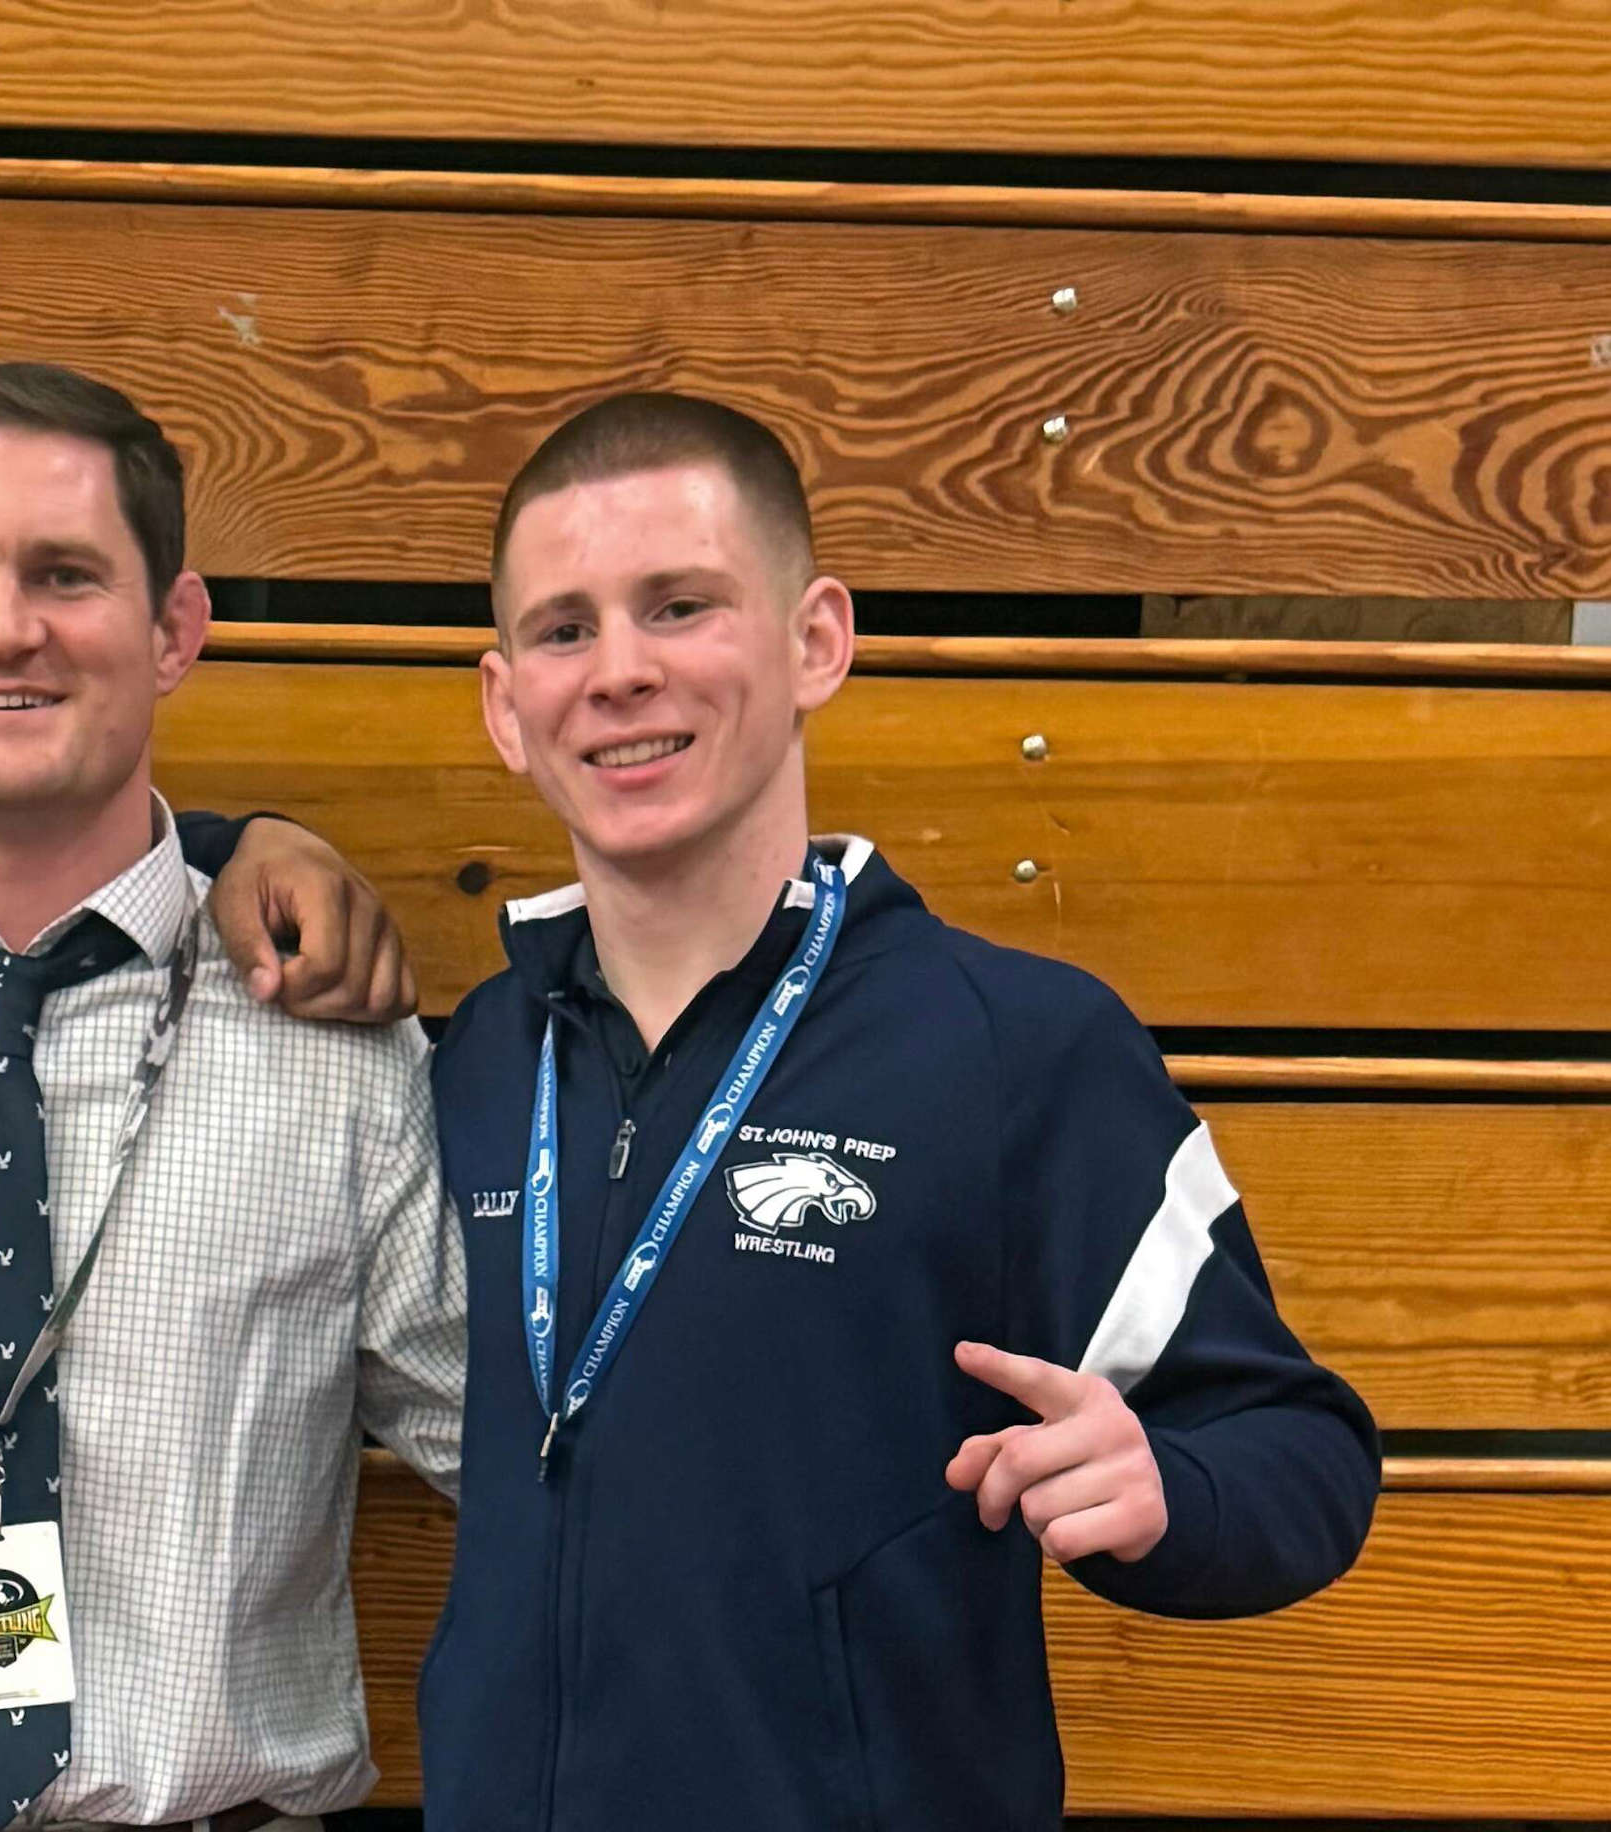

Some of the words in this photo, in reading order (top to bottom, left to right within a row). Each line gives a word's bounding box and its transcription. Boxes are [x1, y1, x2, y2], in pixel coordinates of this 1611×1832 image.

[803, 891, 836, 967] CHAMPION
[725, 1021, 778, 1104] CHAMPION
[843, 1138, 897, 1162] PREP
[533, 1198, 549, 1278] CHAMPION
[650, 1160, 701, 1242] CHAMPION
[734, 1232, 836, 1263] WRESTLING
[582, 1298, 631, 1378] CHAMPION
